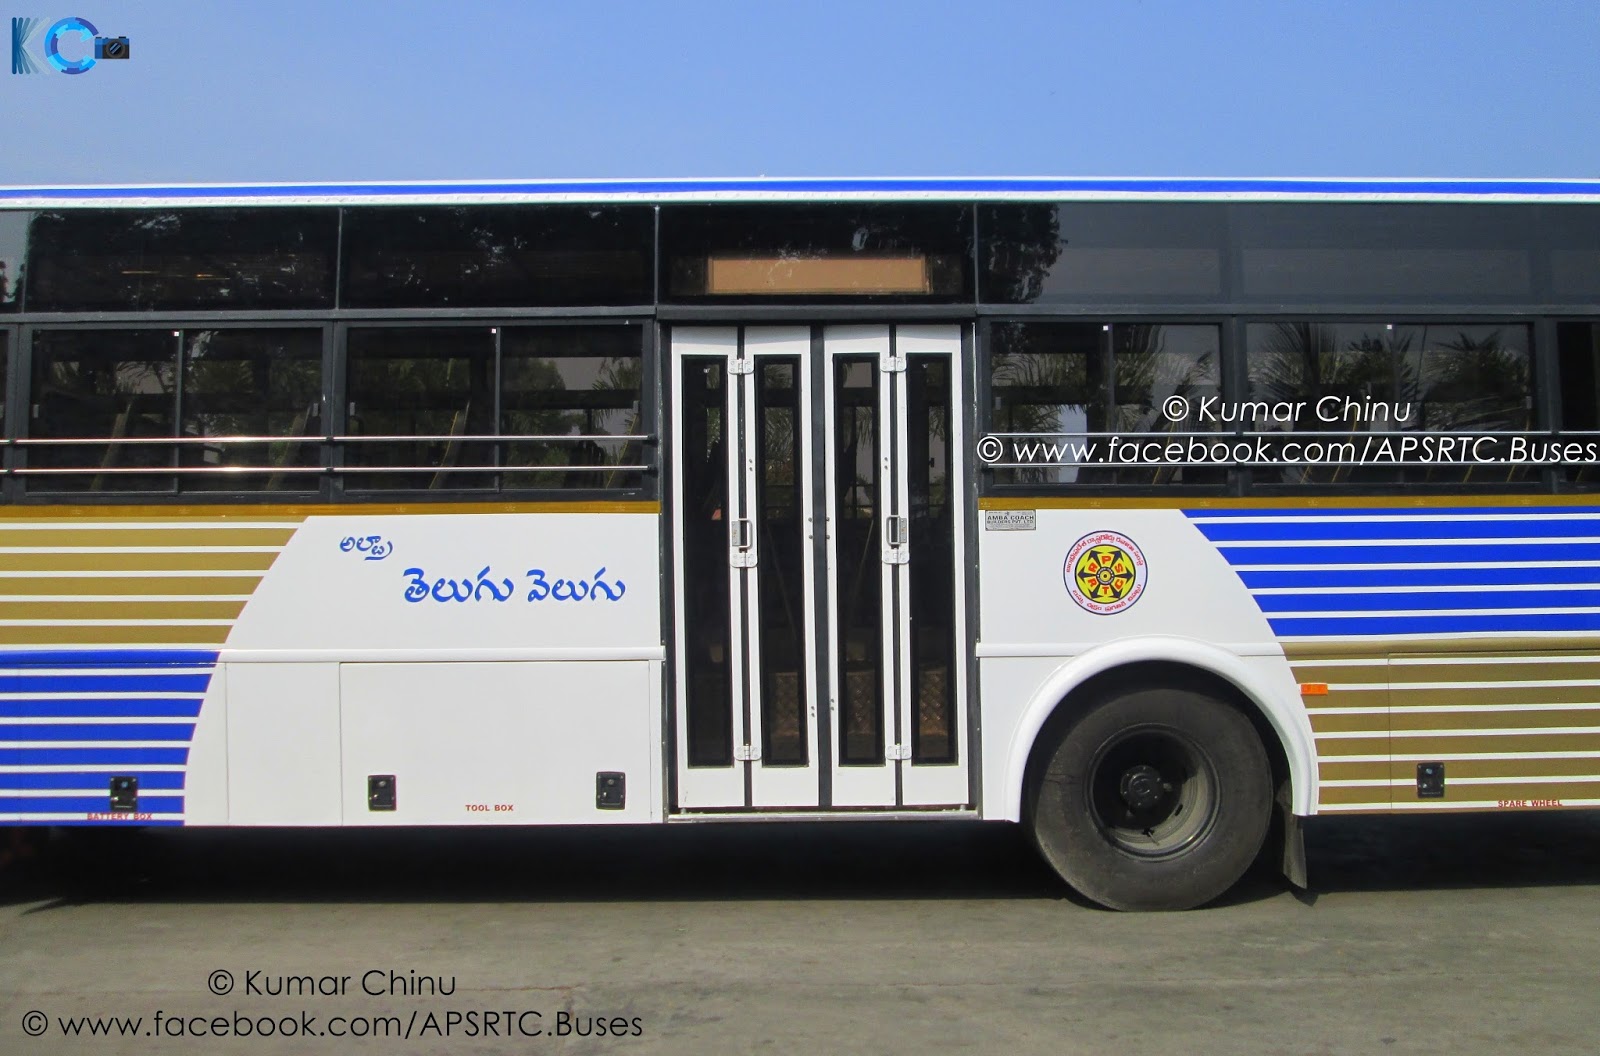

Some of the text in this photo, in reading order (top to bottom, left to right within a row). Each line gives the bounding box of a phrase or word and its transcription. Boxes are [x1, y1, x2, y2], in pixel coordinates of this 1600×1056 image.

[402, 565, 626, 603] తెలుగు వెలుగు
[1498, 798, 1563, 807] SPARE WHEEL
[87, 812, 153, 820] BATTERY BOX
